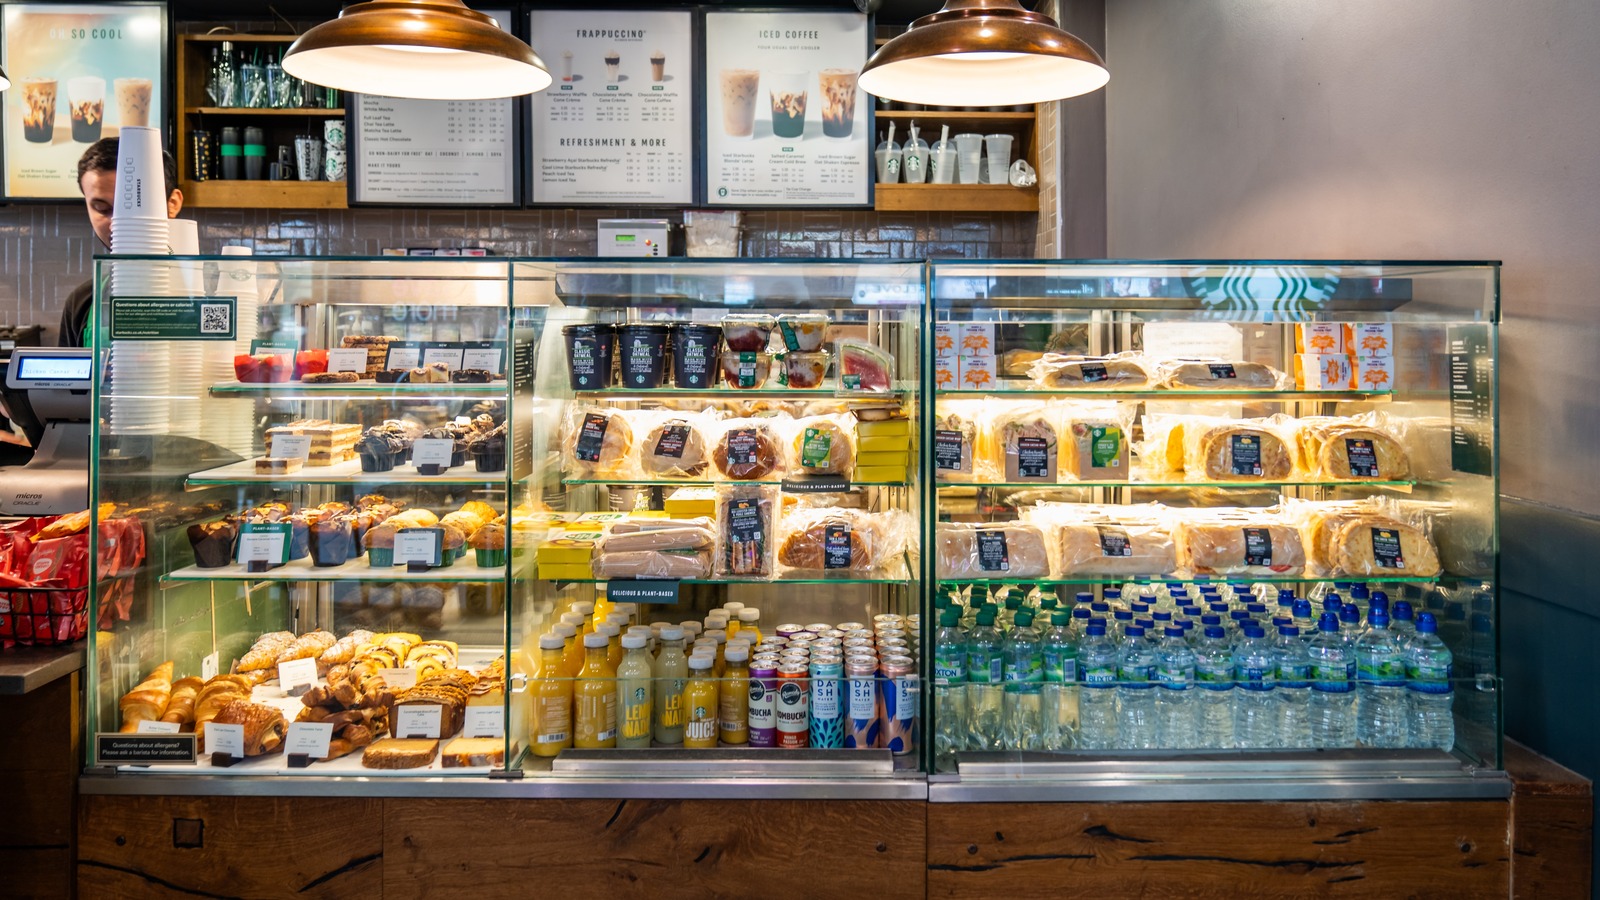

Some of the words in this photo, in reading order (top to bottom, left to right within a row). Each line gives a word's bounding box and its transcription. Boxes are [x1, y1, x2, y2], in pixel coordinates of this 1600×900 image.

[50, 29, 65, 39] OH
[72, 29, 85, 39] SO
[92, 29, 122, 39] COOL
[760, 30, 780, 38] ICED
[786, 30, 818, 38] COFFEE
[560, 138, 626, 147] REFRESHMENT
[631, 138, 636, 147] &
[642, 138, 666, 147] MORE
[782, 690, 800, 699] Remedy
[626, 702, 650, 720] LEM
[686, 721, 715, 738] JUICE
